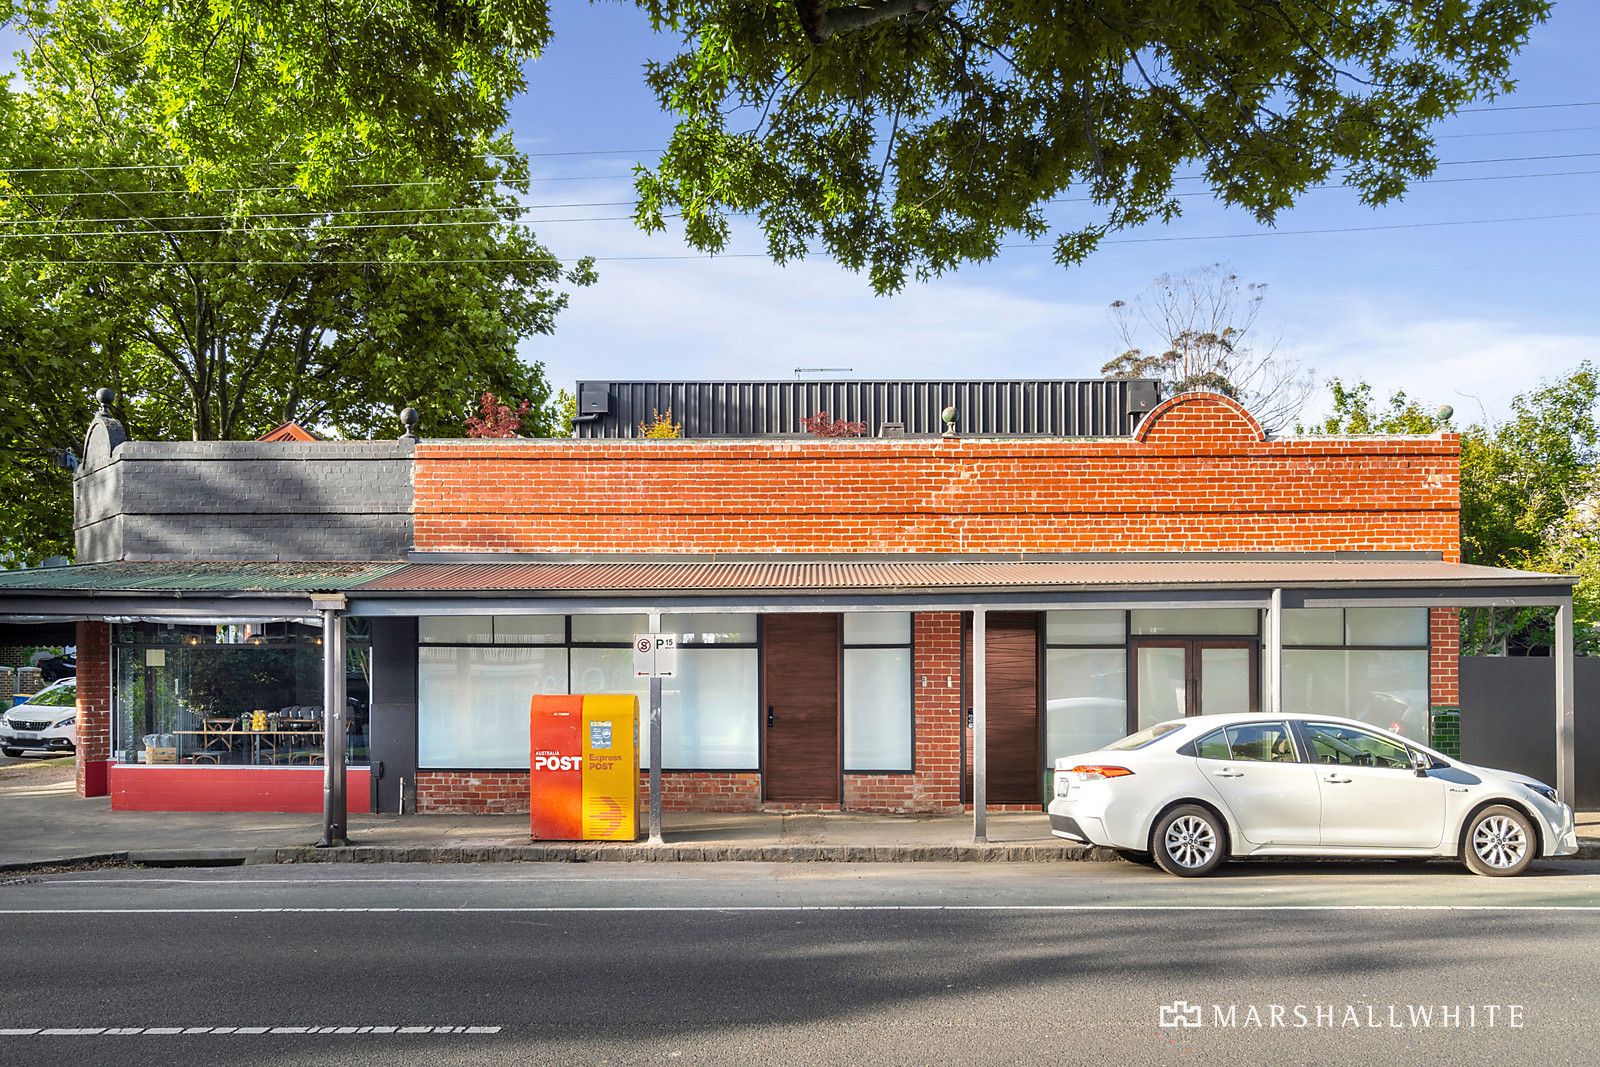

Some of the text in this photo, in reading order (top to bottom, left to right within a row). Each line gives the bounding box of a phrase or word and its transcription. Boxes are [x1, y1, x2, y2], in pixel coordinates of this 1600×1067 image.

[656, 639, 664, 649] P
[535, 756, 582, 770] POST
[589, 754, 622, 762] Express
